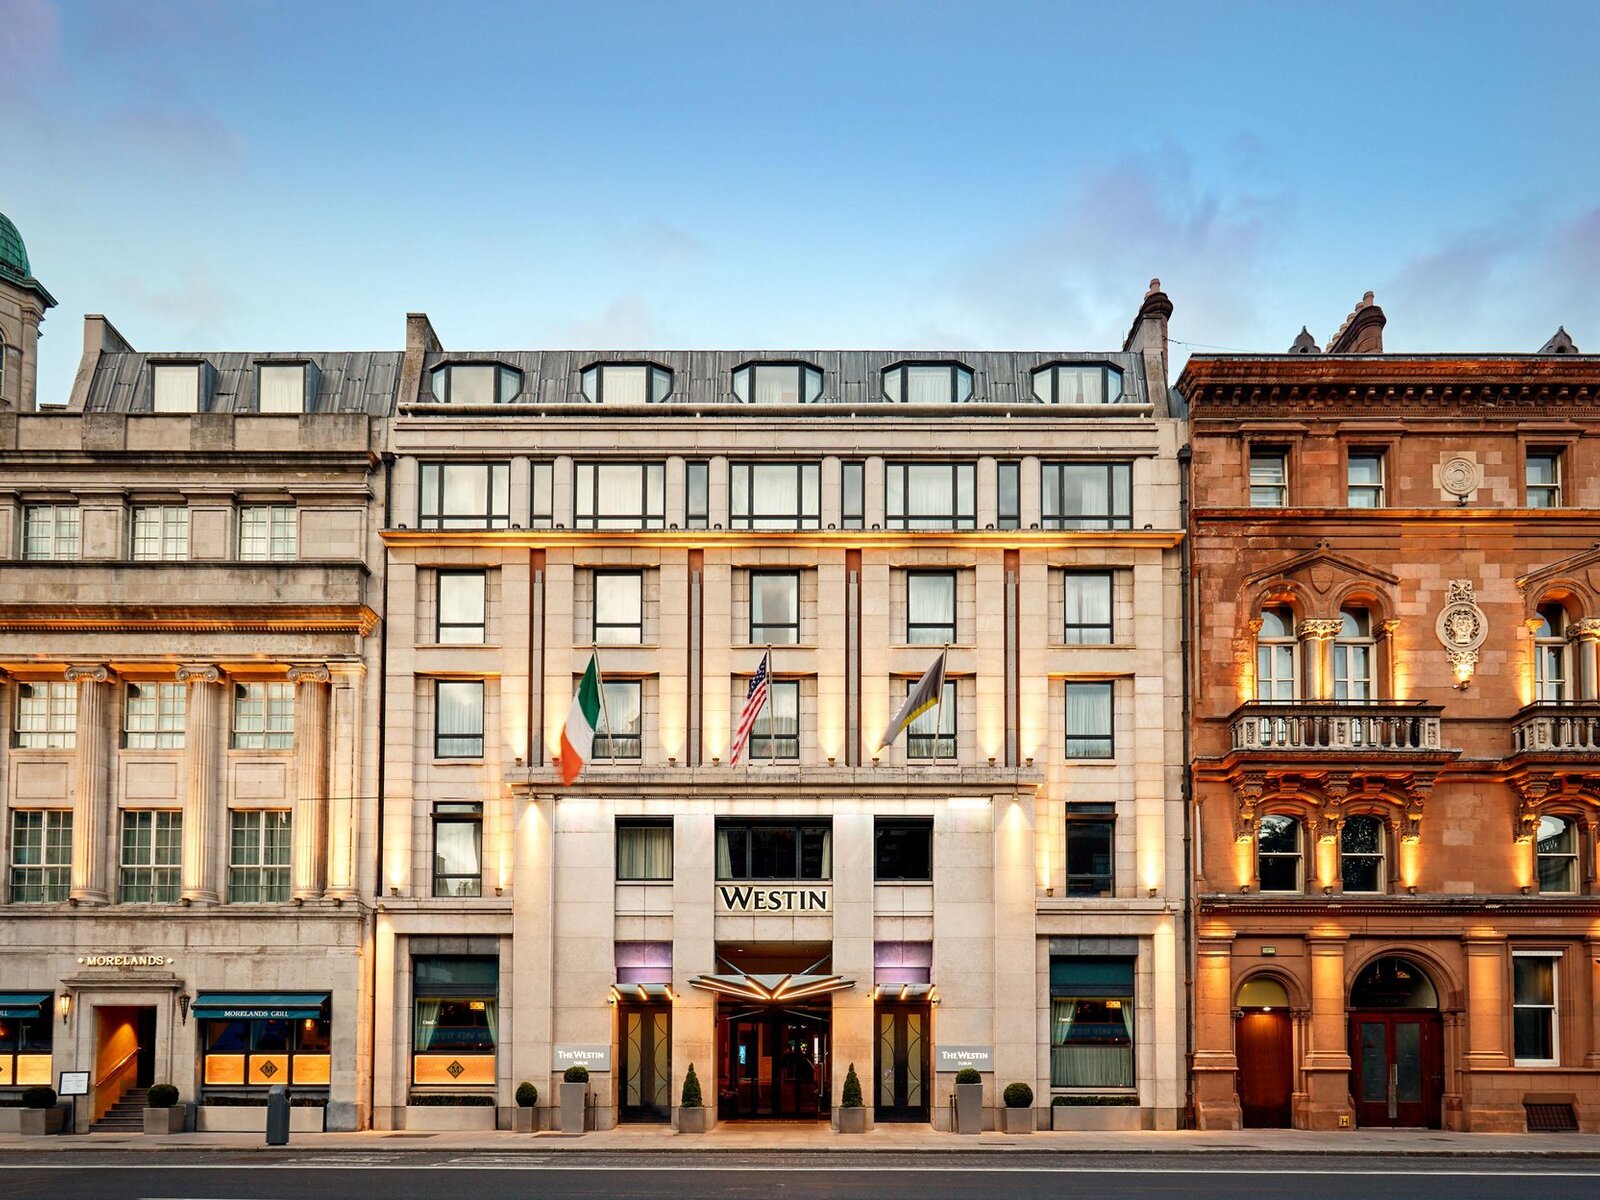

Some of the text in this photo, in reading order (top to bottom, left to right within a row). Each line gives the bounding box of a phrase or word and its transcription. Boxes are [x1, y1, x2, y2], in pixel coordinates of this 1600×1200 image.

[719, 886, 827, 910] WESTIN
[86, 956, 164, 966] MORELANDS
[558, 1050, 604, 1059] THE WESTIN
[942, 1051, 988, 1059] THE WESTIN
